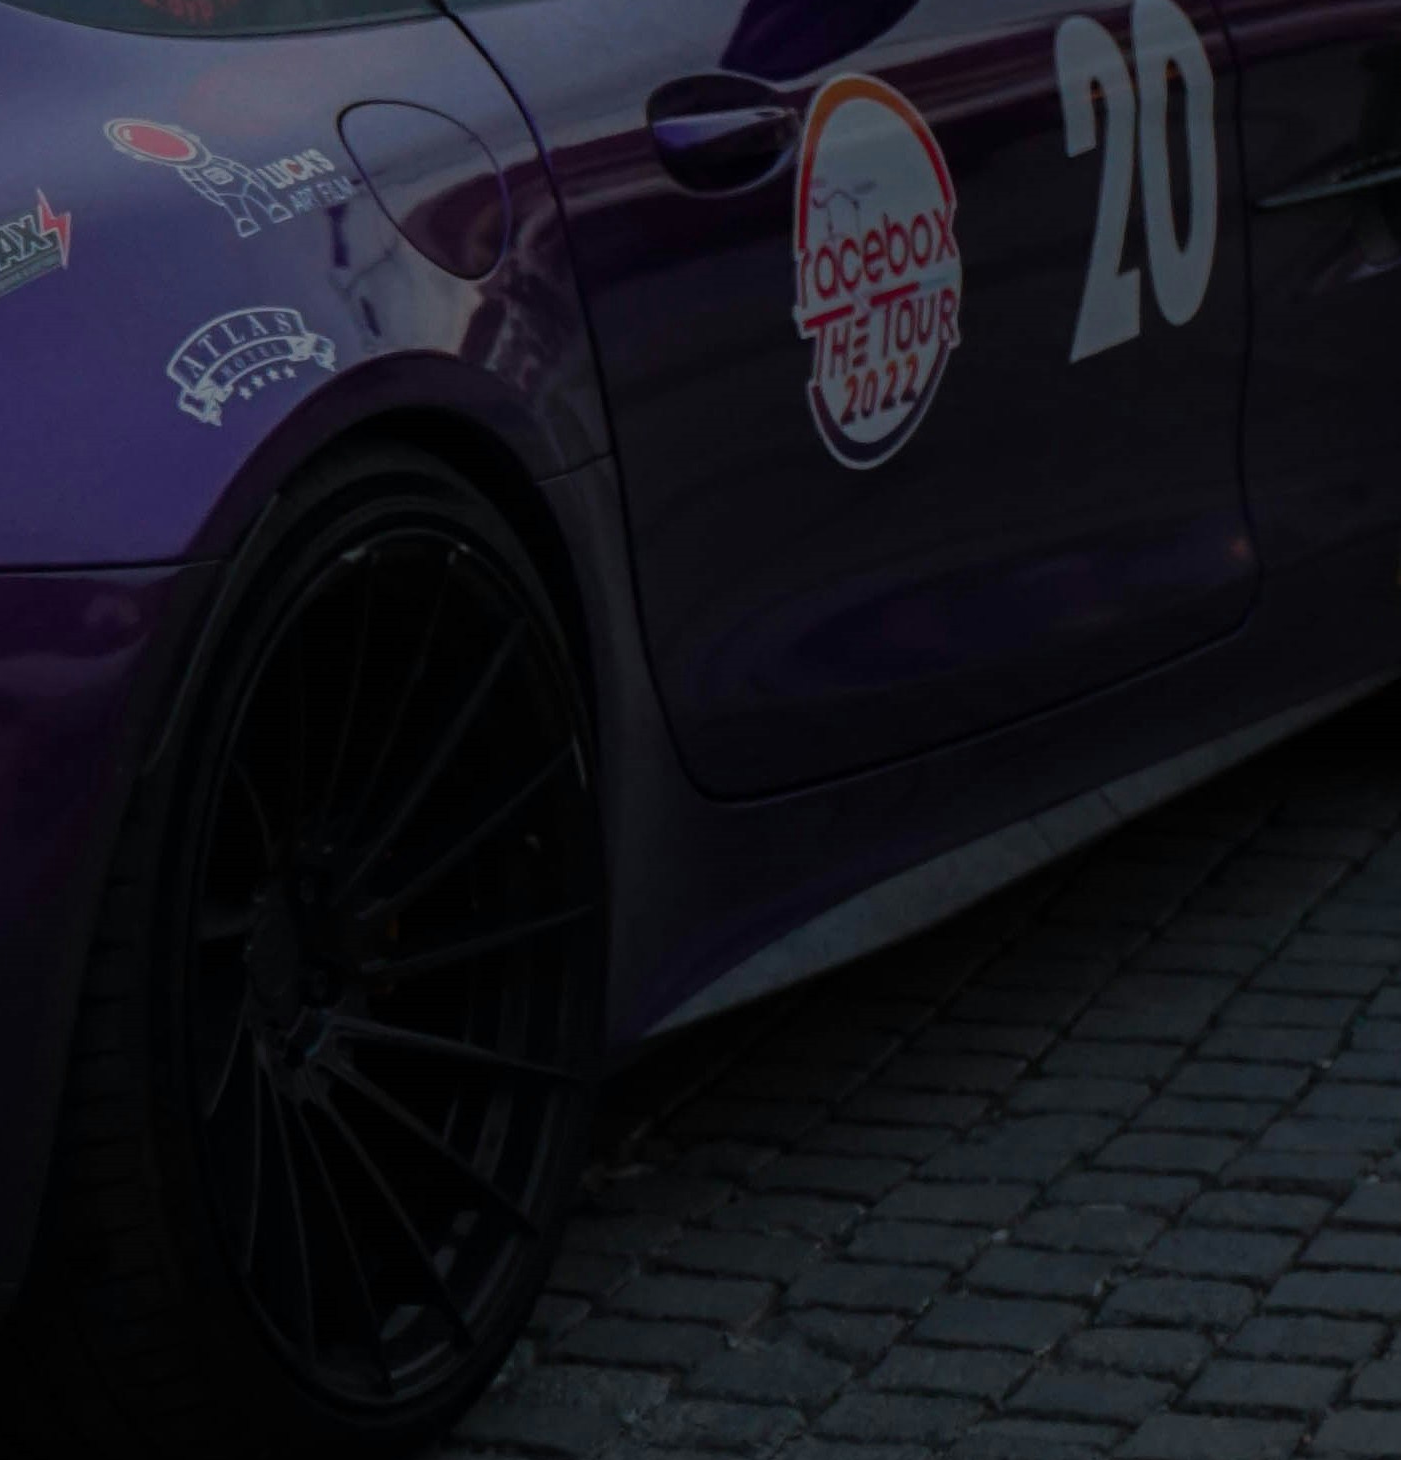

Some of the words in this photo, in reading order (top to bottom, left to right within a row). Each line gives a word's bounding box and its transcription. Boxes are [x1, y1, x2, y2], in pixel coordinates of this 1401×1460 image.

[801, 209, 957, 310] racebox
[181, 312, 293, 379] ATLAS
[803, 303, 870, 384] THE
[870, 282, 958, 360] TOUR
[840, 353, 920, 426] 2022
